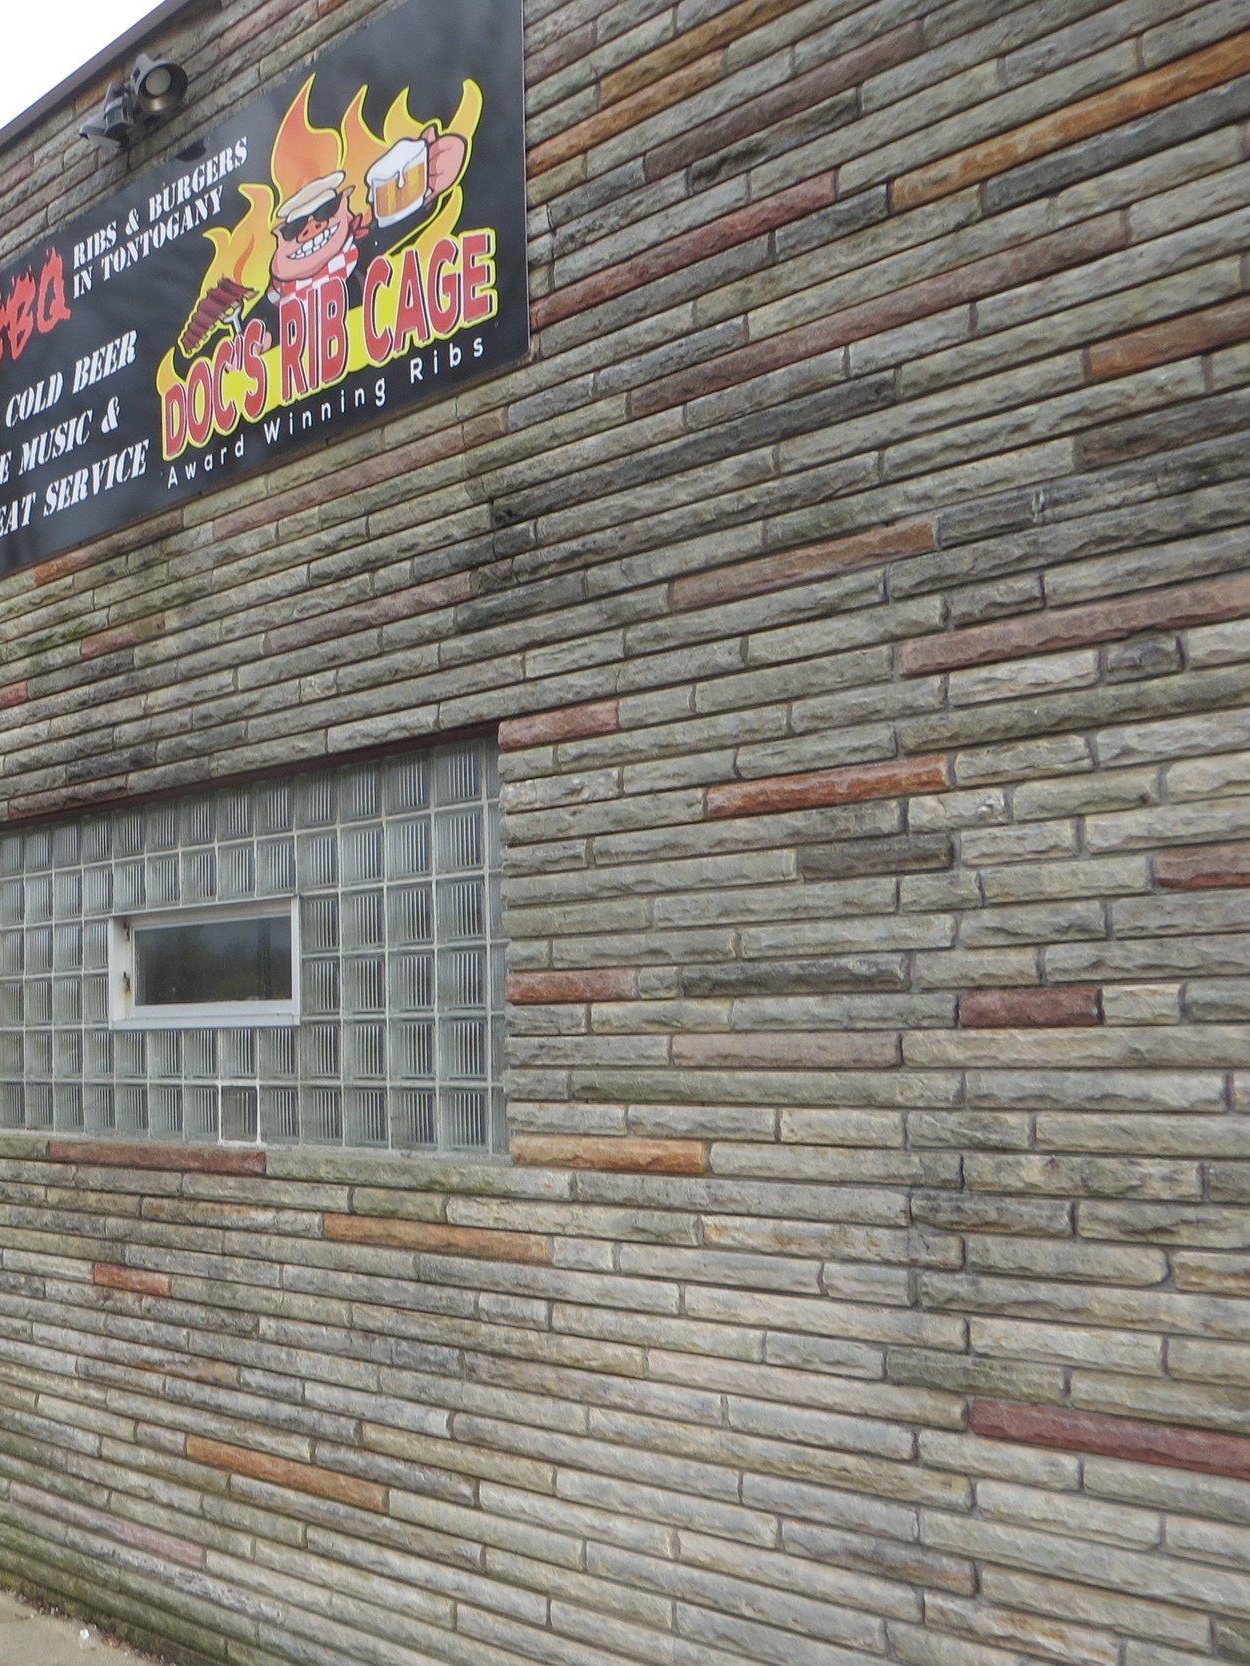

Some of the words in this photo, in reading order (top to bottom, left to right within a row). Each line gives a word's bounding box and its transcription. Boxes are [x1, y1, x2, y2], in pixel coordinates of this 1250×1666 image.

[73, 220, 117, 270] RIBS
[125, 208, 139, 236] &
[149, 136, 248, 223] BURGERS
[73, 266, 93, 300] IN
[101, 185, 223, 282] TONTOGANY
[5, 371, 64, 428] COLD
[72, 330, 138, 394] BEER
[162, 317, 268, 460] DOC'S
[279, 276, 350, 402] RIB
[362, 232, 491, 363] CAGE
[18, 409, 93, 476] MUSIC
[101, 395, 120, 434] &
[167, 435, 244, 489] Award
[264, 377, 386, 444] Winning
[410, 337, 484, 384] Ribs
[43, 439, 149, 517] SERVICE
